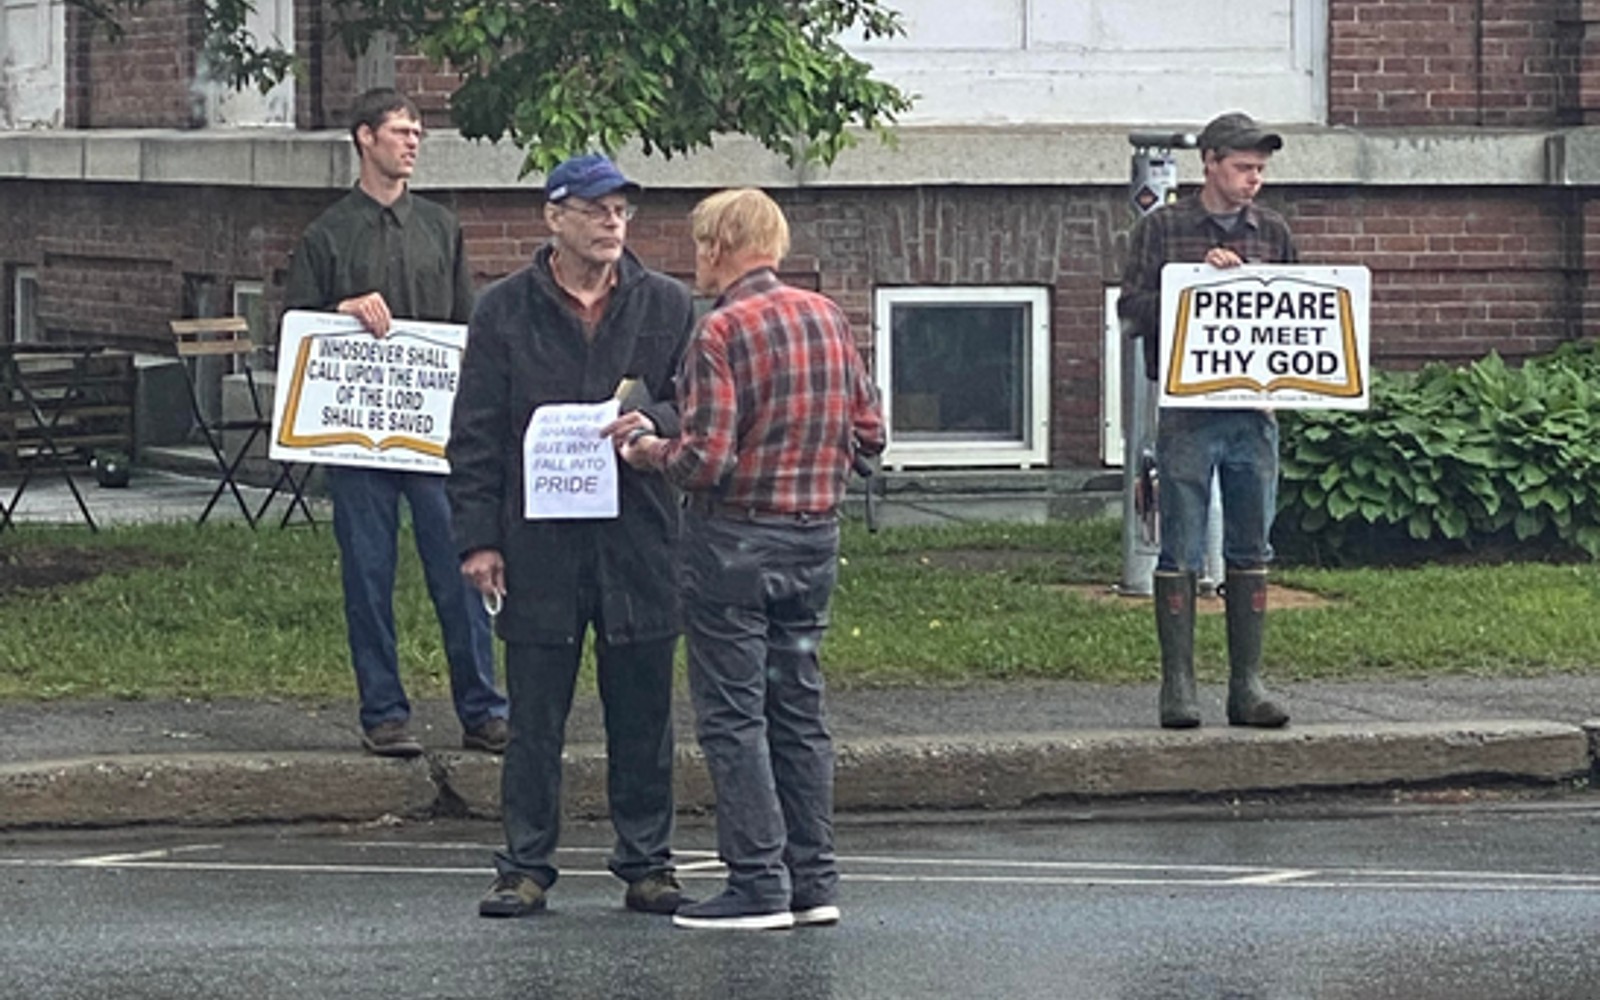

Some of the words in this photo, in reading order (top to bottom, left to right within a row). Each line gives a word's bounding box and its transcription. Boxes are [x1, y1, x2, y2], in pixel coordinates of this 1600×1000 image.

[1194, 291, 1336, 320] PREPARE
[1203, 324, 1241, 345] TO
[1251, 326, 1327, 345] MEET
[318, 339, 402, 364] WHOSOEVER
[406, 347, 449, 369] SHALL
[1191, 350, 1255, 374] THY
[1267, 350, 1339, 375] GOD
[307, 359, 341, 381] CALL
[345, 364, 384, 384] UPON
[389, 367, 413, 387] THE
[417, 370, 457, 392] NAME
[336, 385, 355, 404] OF
[359, 387, 384, 407] THE
[386, 391, 424, 411] LORD
[321, 406, 364, 428] SHALL
[368, 411, 384, 430] BE
[388, 413, 434, 434] SAVED
[533, 441, 562, 455] BUT
[566, 441, 602, 455] WHY
[533, 457, 566, 472] FALL
[569, 457, 606, 472] INTO
[534, 475, 600, 494] PRIDE
